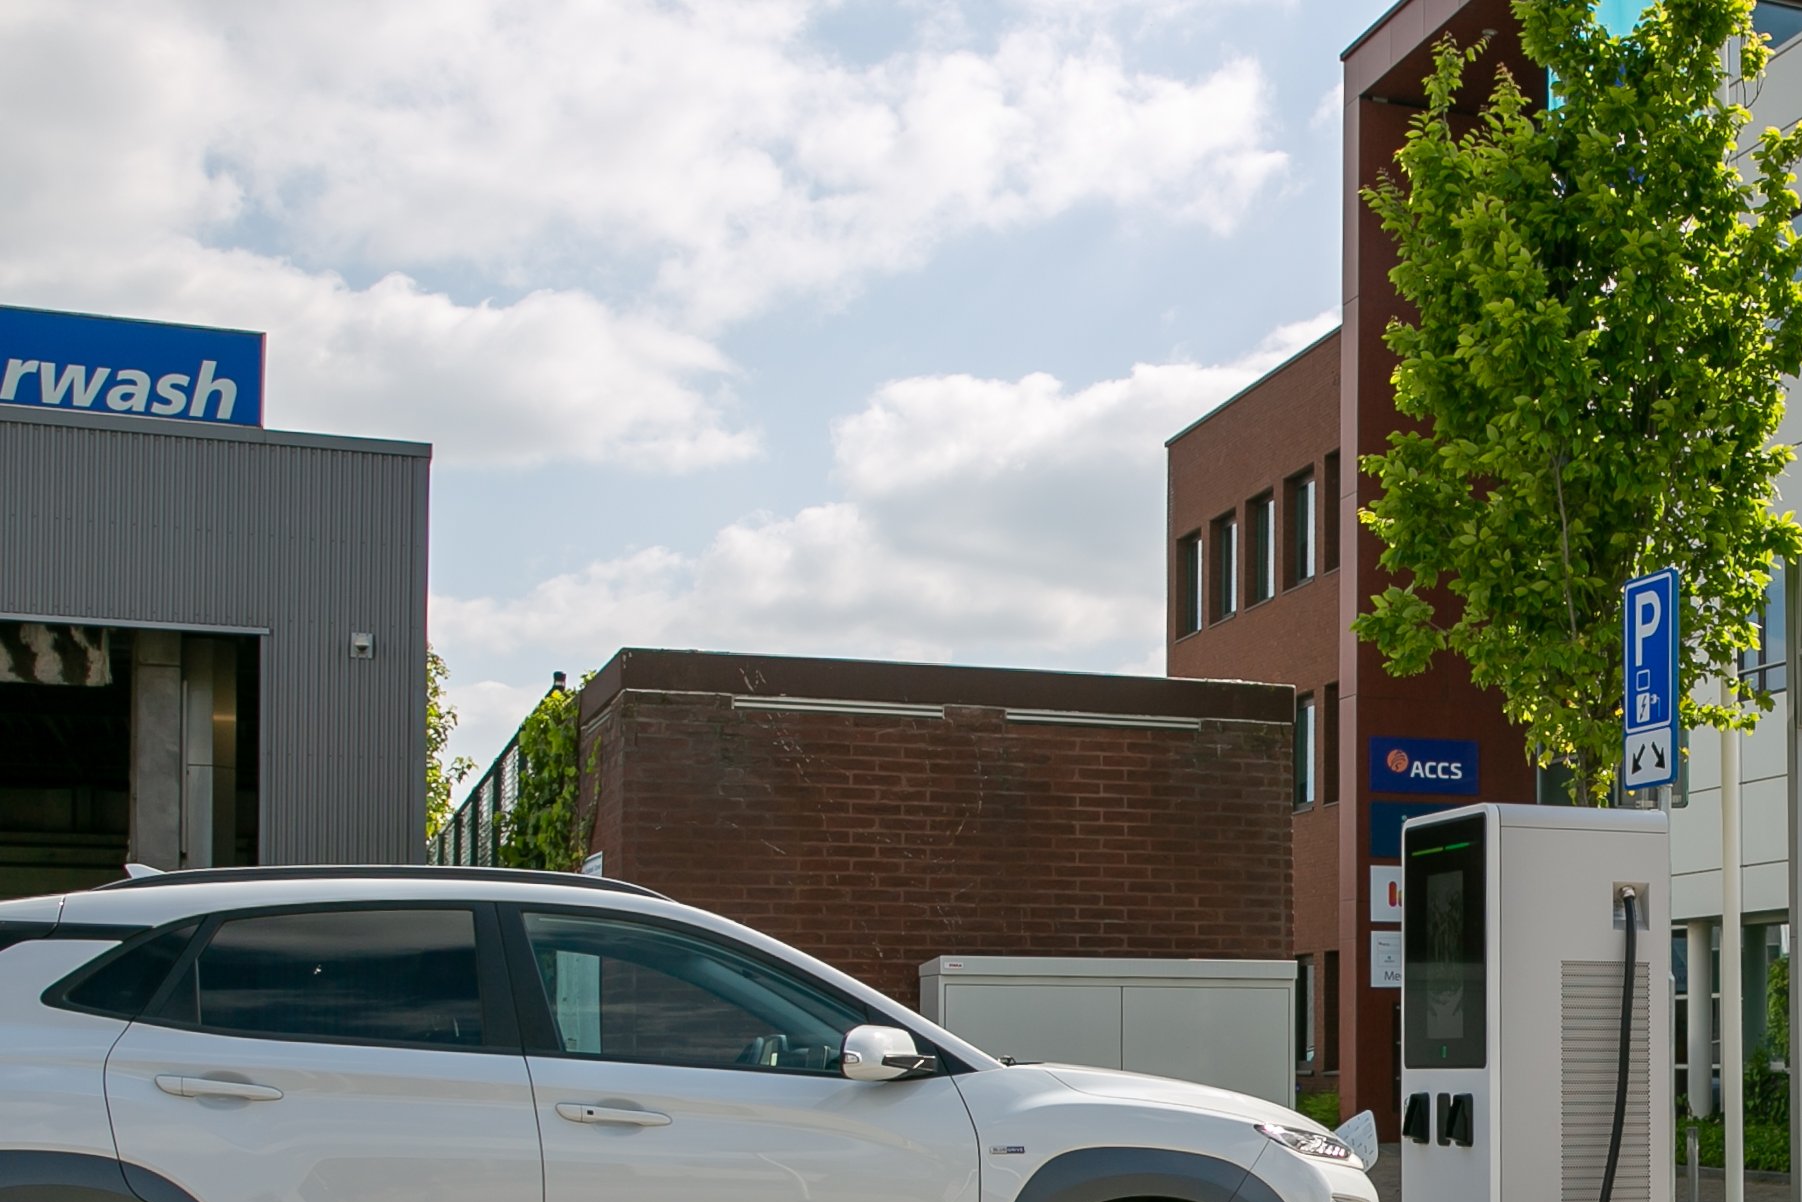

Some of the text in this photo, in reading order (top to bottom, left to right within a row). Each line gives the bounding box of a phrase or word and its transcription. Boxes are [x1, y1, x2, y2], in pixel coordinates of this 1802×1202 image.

[0, 358, 238, 420] rwash
[1634, 590, 1662, 668] P
[1410, 761, 1463, 780] ACCS
